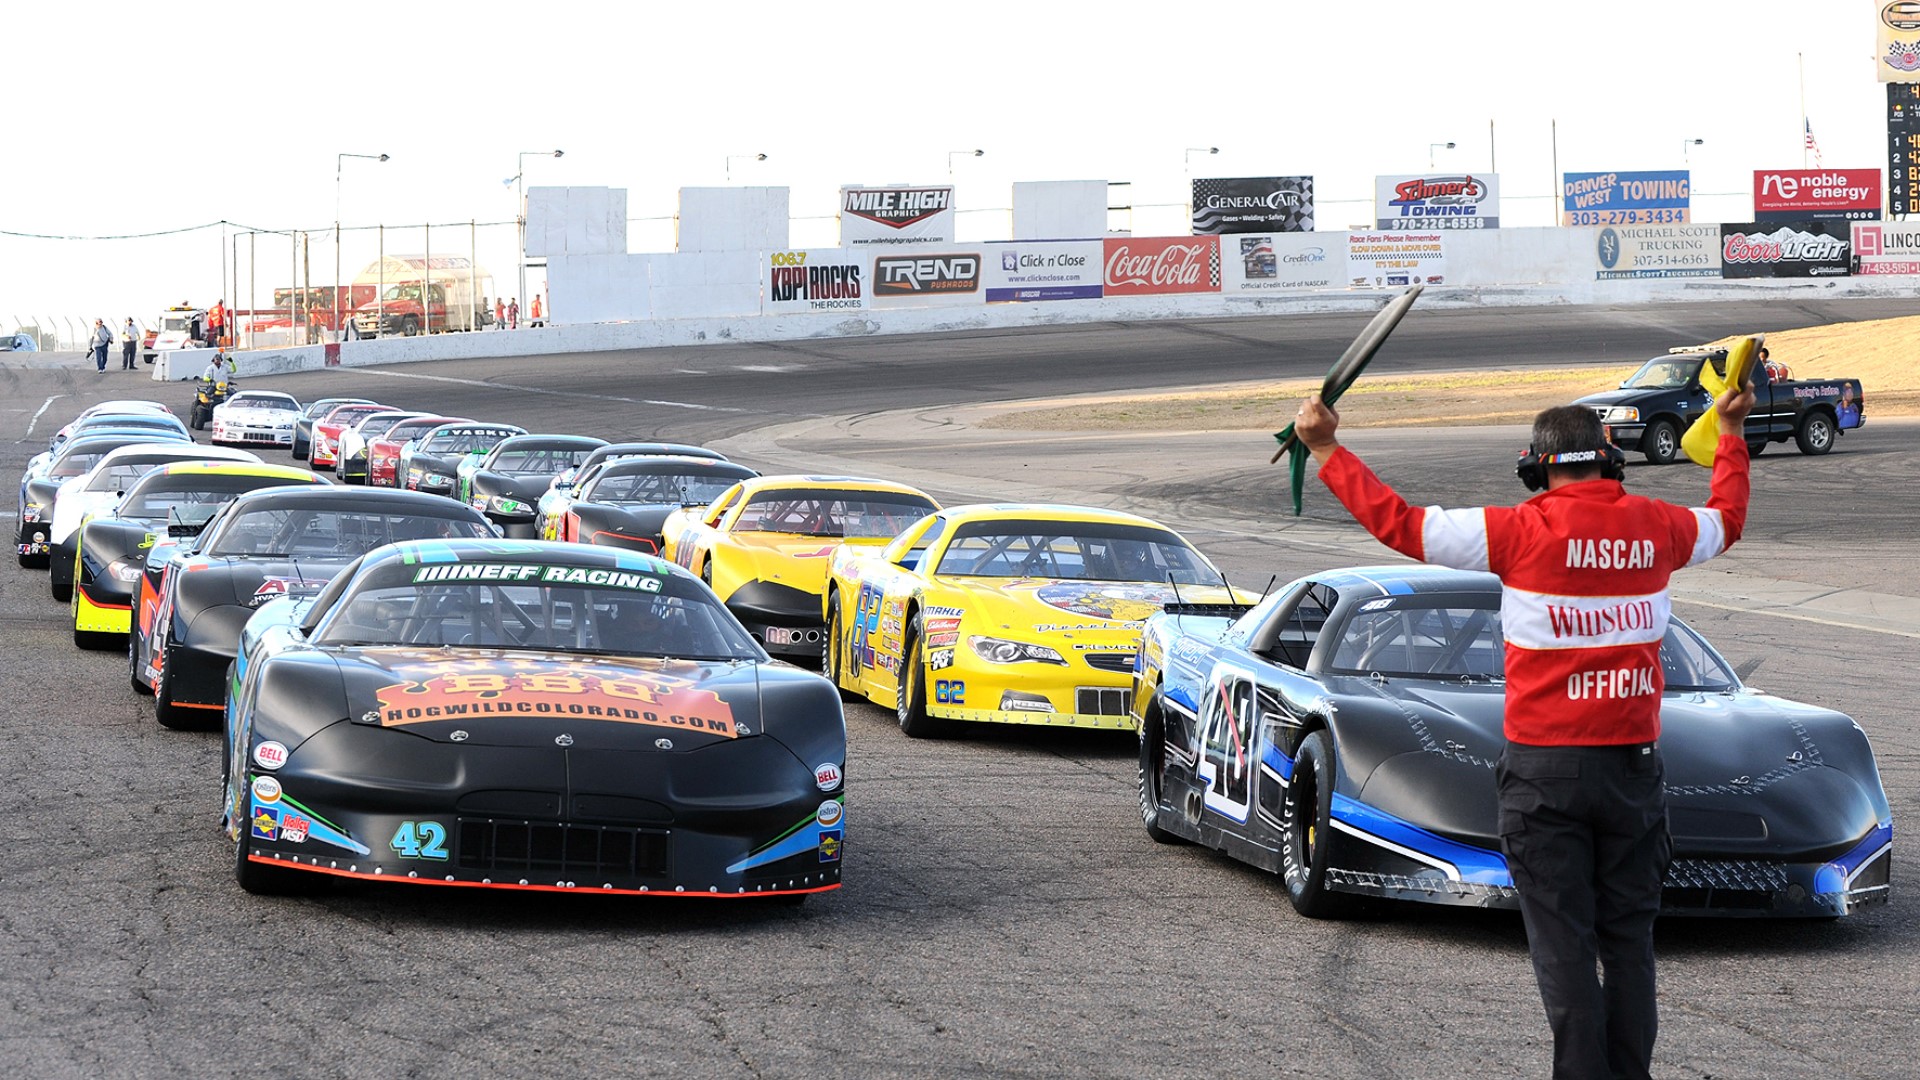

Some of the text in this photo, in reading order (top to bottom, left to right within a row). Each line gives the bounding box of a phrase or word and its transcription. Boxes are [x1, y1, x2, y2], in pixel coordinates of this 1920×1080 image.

[1894, 137, 1900, 147] 1
[1893, 153, 1901, 163] 2
[1801, 173, 1847, 187] noble
[1893, 169, 1902, 180] 3
[1395, 175, 1478, 202] Schmer's
[1565, 173, 1617, 197] DENVER
[1620, 179, 1689, 201] TOWING
[1893, 186, 1902, 196] 4
[848, 190, 950, 210] MILE HIGH
[1574, 188, 1612, 209] WEST
[1812, 186, 1869, 200] energy
[1894, 201, 1902, 212] 5
[875, 210, 920, 218] GRAPHICS
[1571, 209, 1684, 225] 303-279-3434
[1392, 218, 1484, 230] 970-226-6558
[852, 236, 943, 244] www.milehighgraphics.com
[1350, 234, 1441, 243] Race Fans Please Remember
[1621, 227, 1719, 239] MICHAEL SCOTT
[1372, 245, 1394, 253] DOWN
[1639, 240, 1703, 250] TRUCKING
[1724, 232, 1849, 263] Coors LIGHT
[771, 253, 807, 266] 106.7
[1020, 251, 1044, 267] Click
[1057, 252, 1085, 267] Close
[1105, 244, 1206, 287] Coca-Cola
[1633, 254, 1709, 266] 307-514-6363
[879, 258, 976, 290] TREND
[1008, 274, 1080, 282] www.clicknclose.com
[771, 265, 861, 301] KBPI ROCKS
[930, 280, 974, 289] PUSHRODS
[1241, 281, 1262, 289] Official
[1263, 281, 1280, 289] Credit
[1282, 281, 1296, 289] Card
[1305, 279, 1327, 287] NASCAR
[811, 300, 862, 309] THE ROCKIES
[1561, 450, 1596, 463] NASCAR
[1566, 539, 1655, 569] NASCAR
[545, 566, 661, 593] RACING
[924, 607, 965, 617] MAHLE
[1547, 600, 1654, 638] Winston
[443, 674, 657, 705] BBQ
[1567, 666, 1656, 700] OFFICIAL
[936, 679, 965, 704] 82
[387, 702, 728, 733] HOGWILDCOLORADO.COM
[259, 746, 282, 763] BELL
[817, 769, 838, 784] BELL
[254, 819, 277, 831] SUNOCO
[283, 814, 311, 835] Holley
[280, 829, 306, 843] MSD
[389, 821, 449, 861] 42
